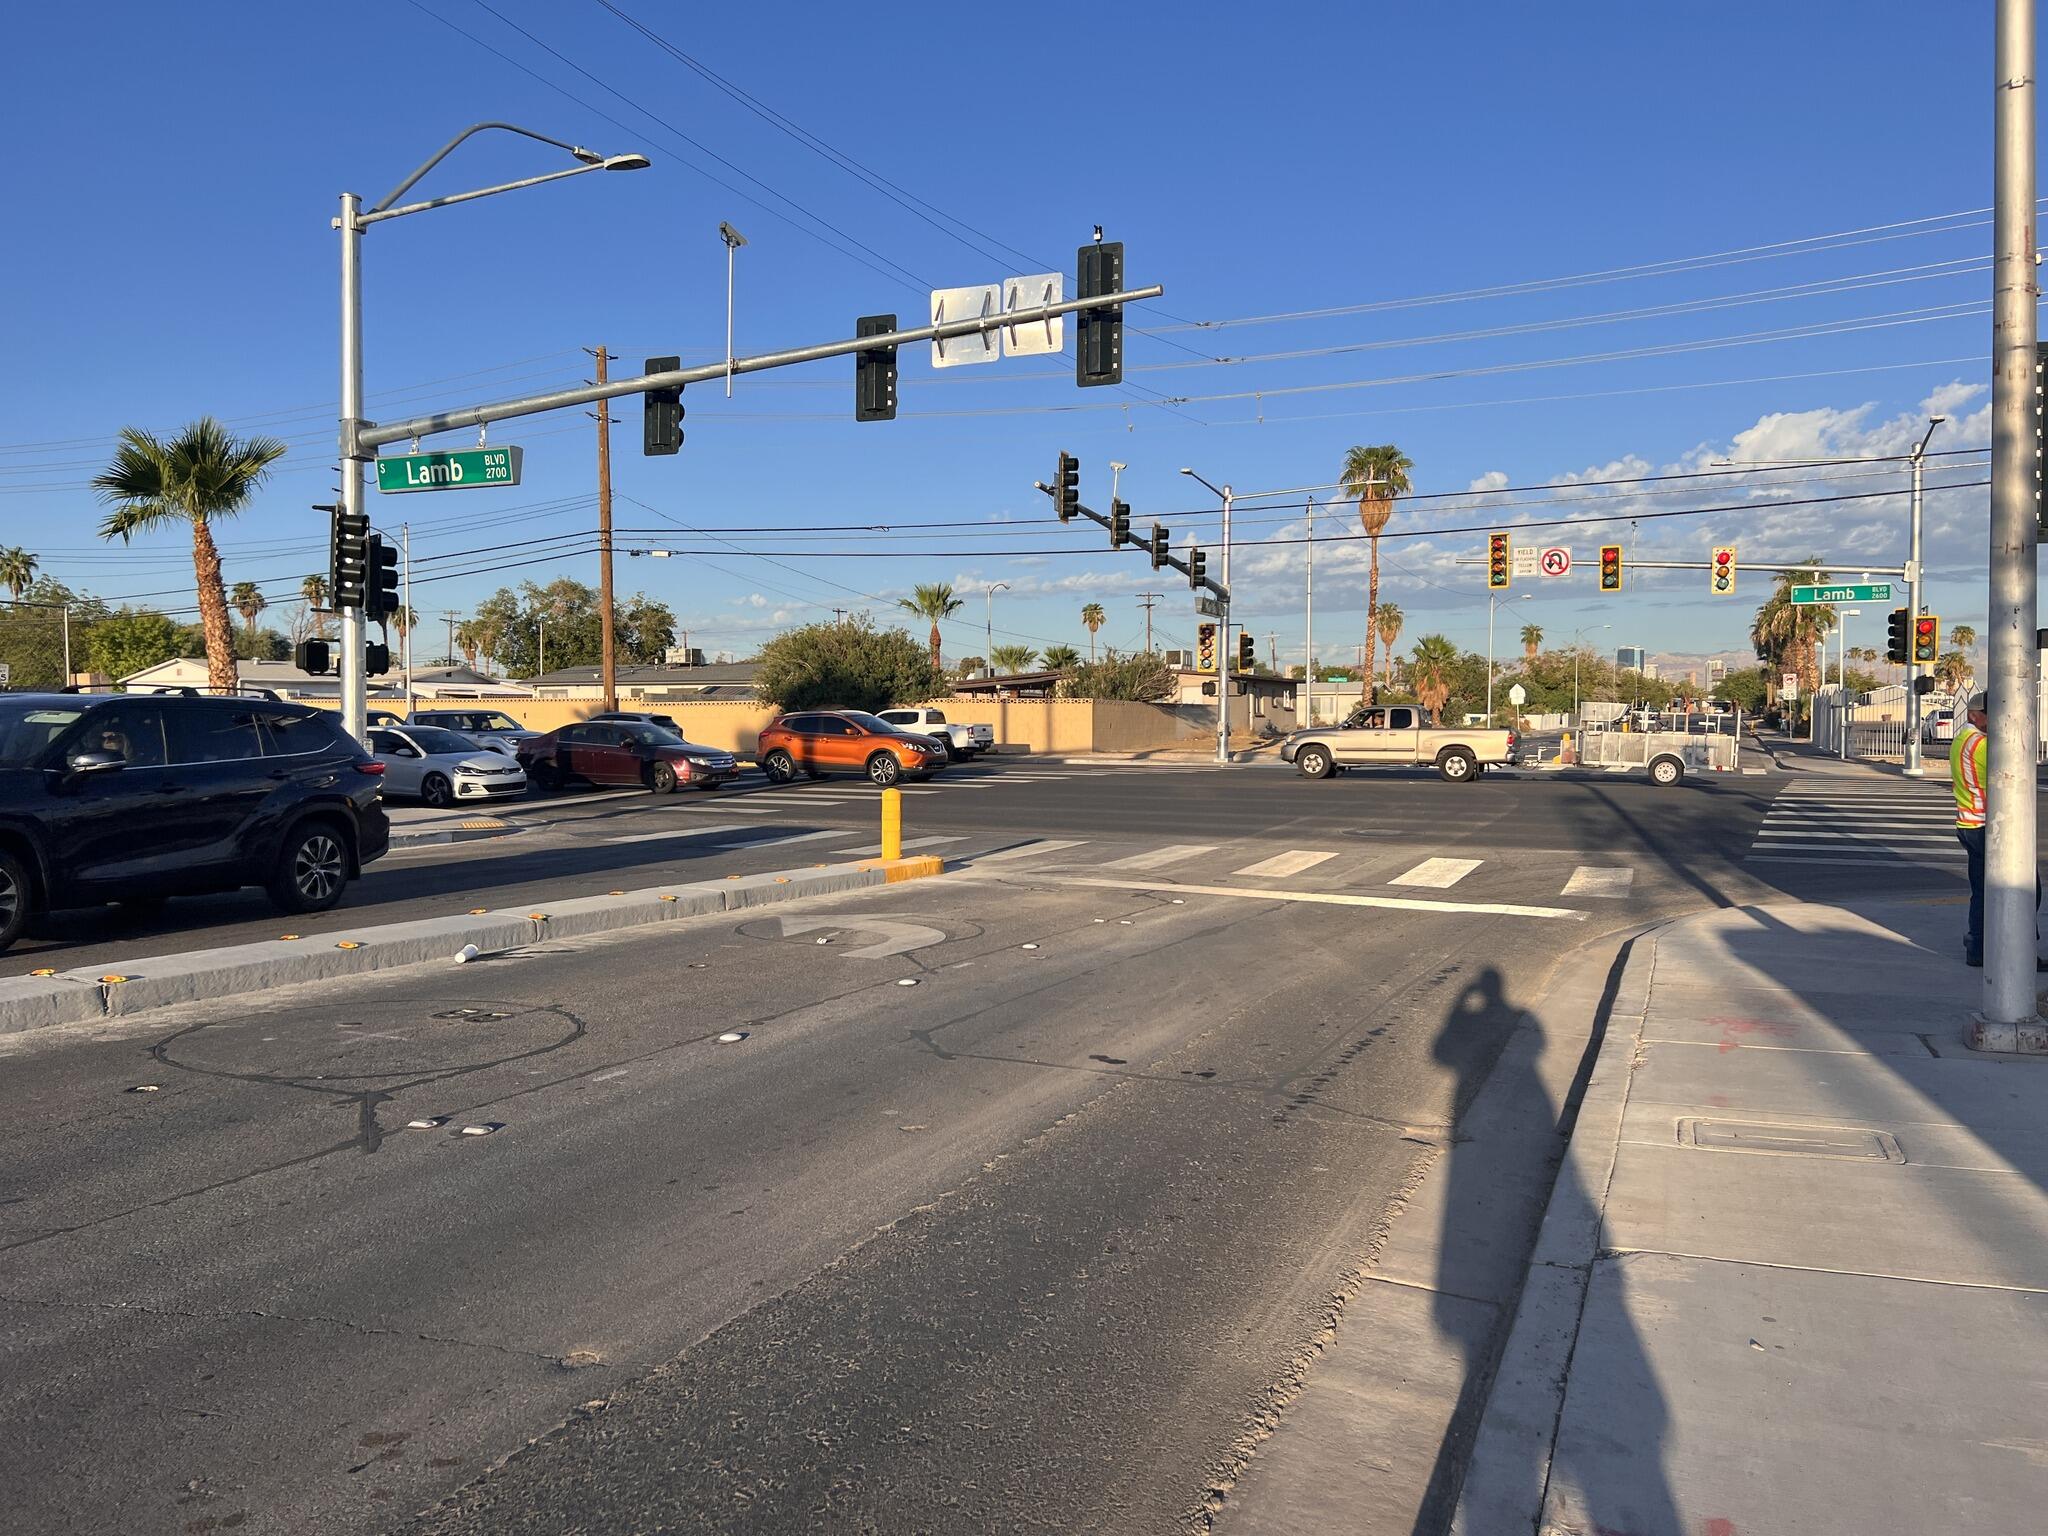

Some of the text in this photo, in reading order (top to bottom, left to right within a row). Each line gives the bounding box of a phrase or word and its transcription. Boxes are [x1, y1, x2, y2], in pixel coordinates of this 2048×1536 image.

[380, 453, 505, 485] S Lamb BLVD
[485, 466, 507, 479] 2700
[1813, 587, 1855, 601] Lamb
